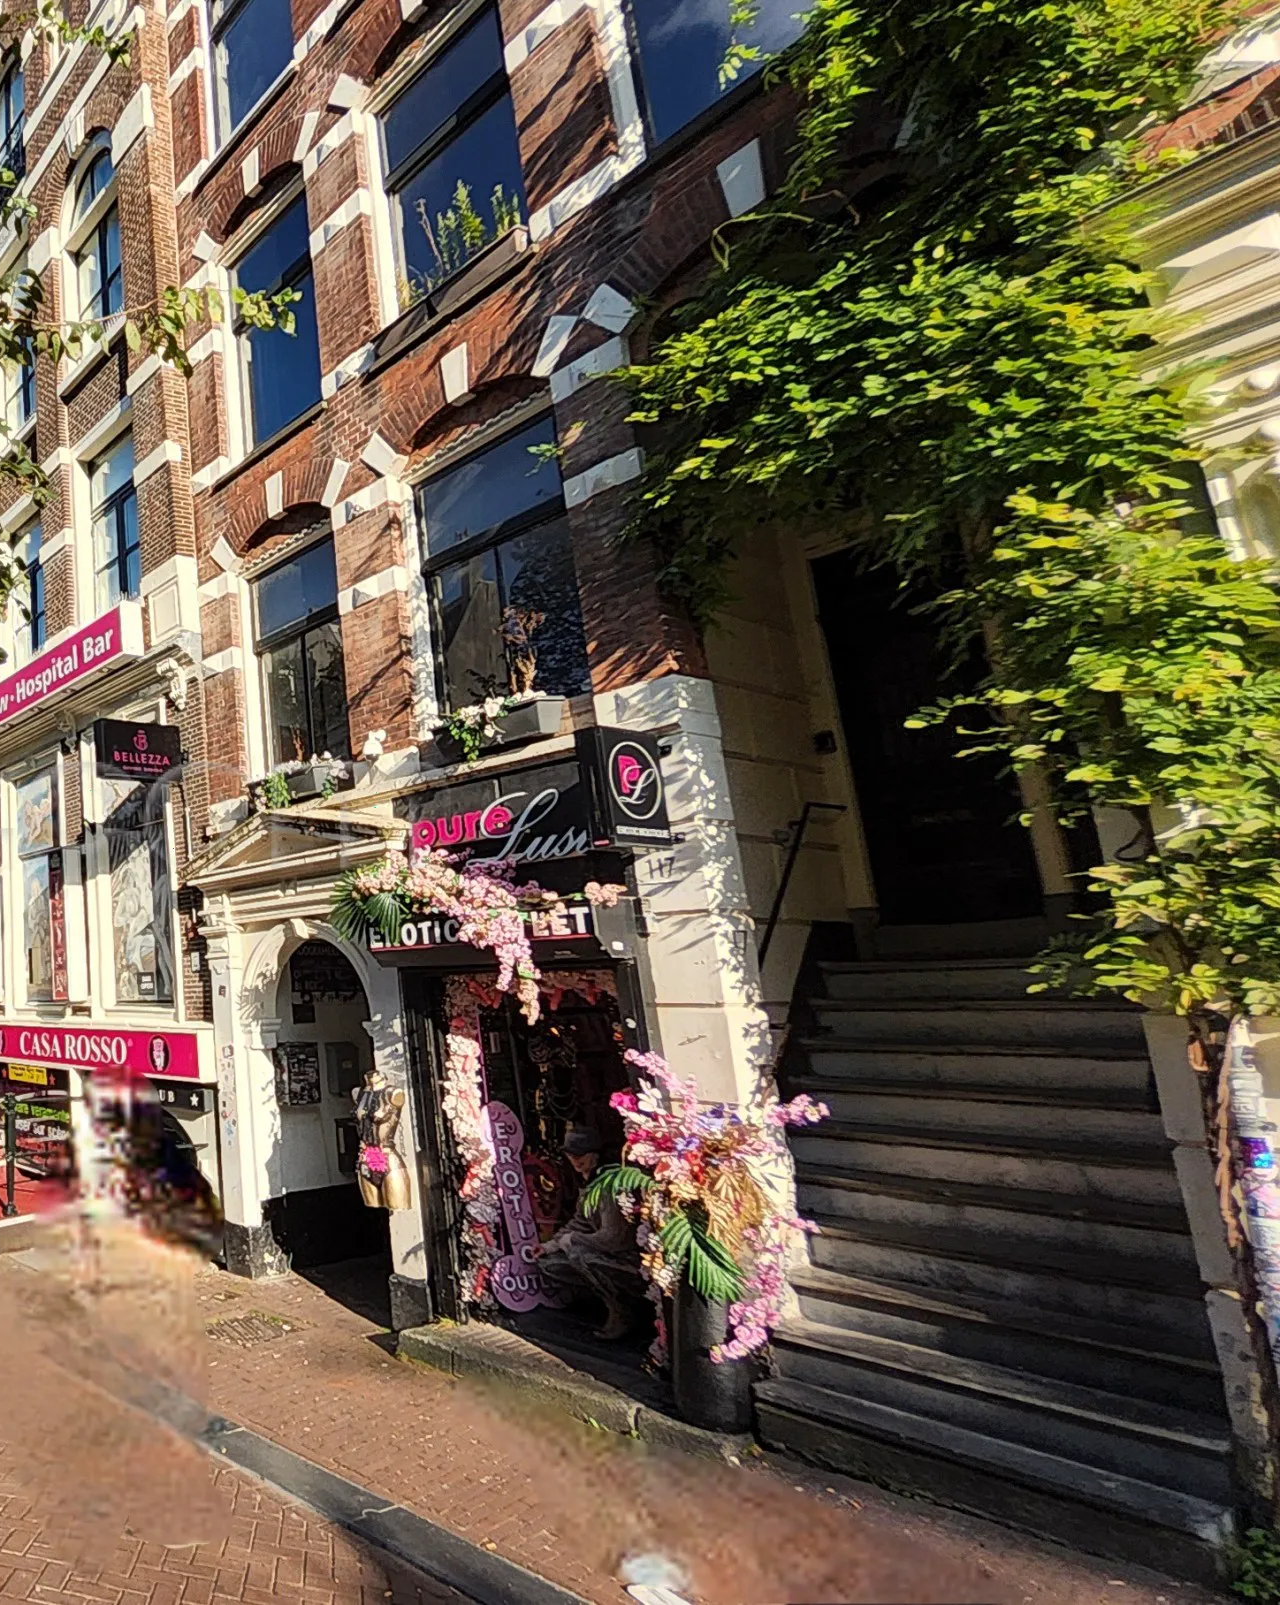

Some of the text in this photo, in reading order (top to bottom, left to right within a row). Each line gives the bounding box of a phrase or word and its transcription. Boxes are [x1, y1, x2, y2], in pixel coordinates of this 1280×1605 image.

[15, 643, 79, 704] Hospital
[82, 628, 114, 664] Bar
[113, 750, 170, 766] BELLEZZA
[19, 1031, 128, 1066] CASA ROSSO
